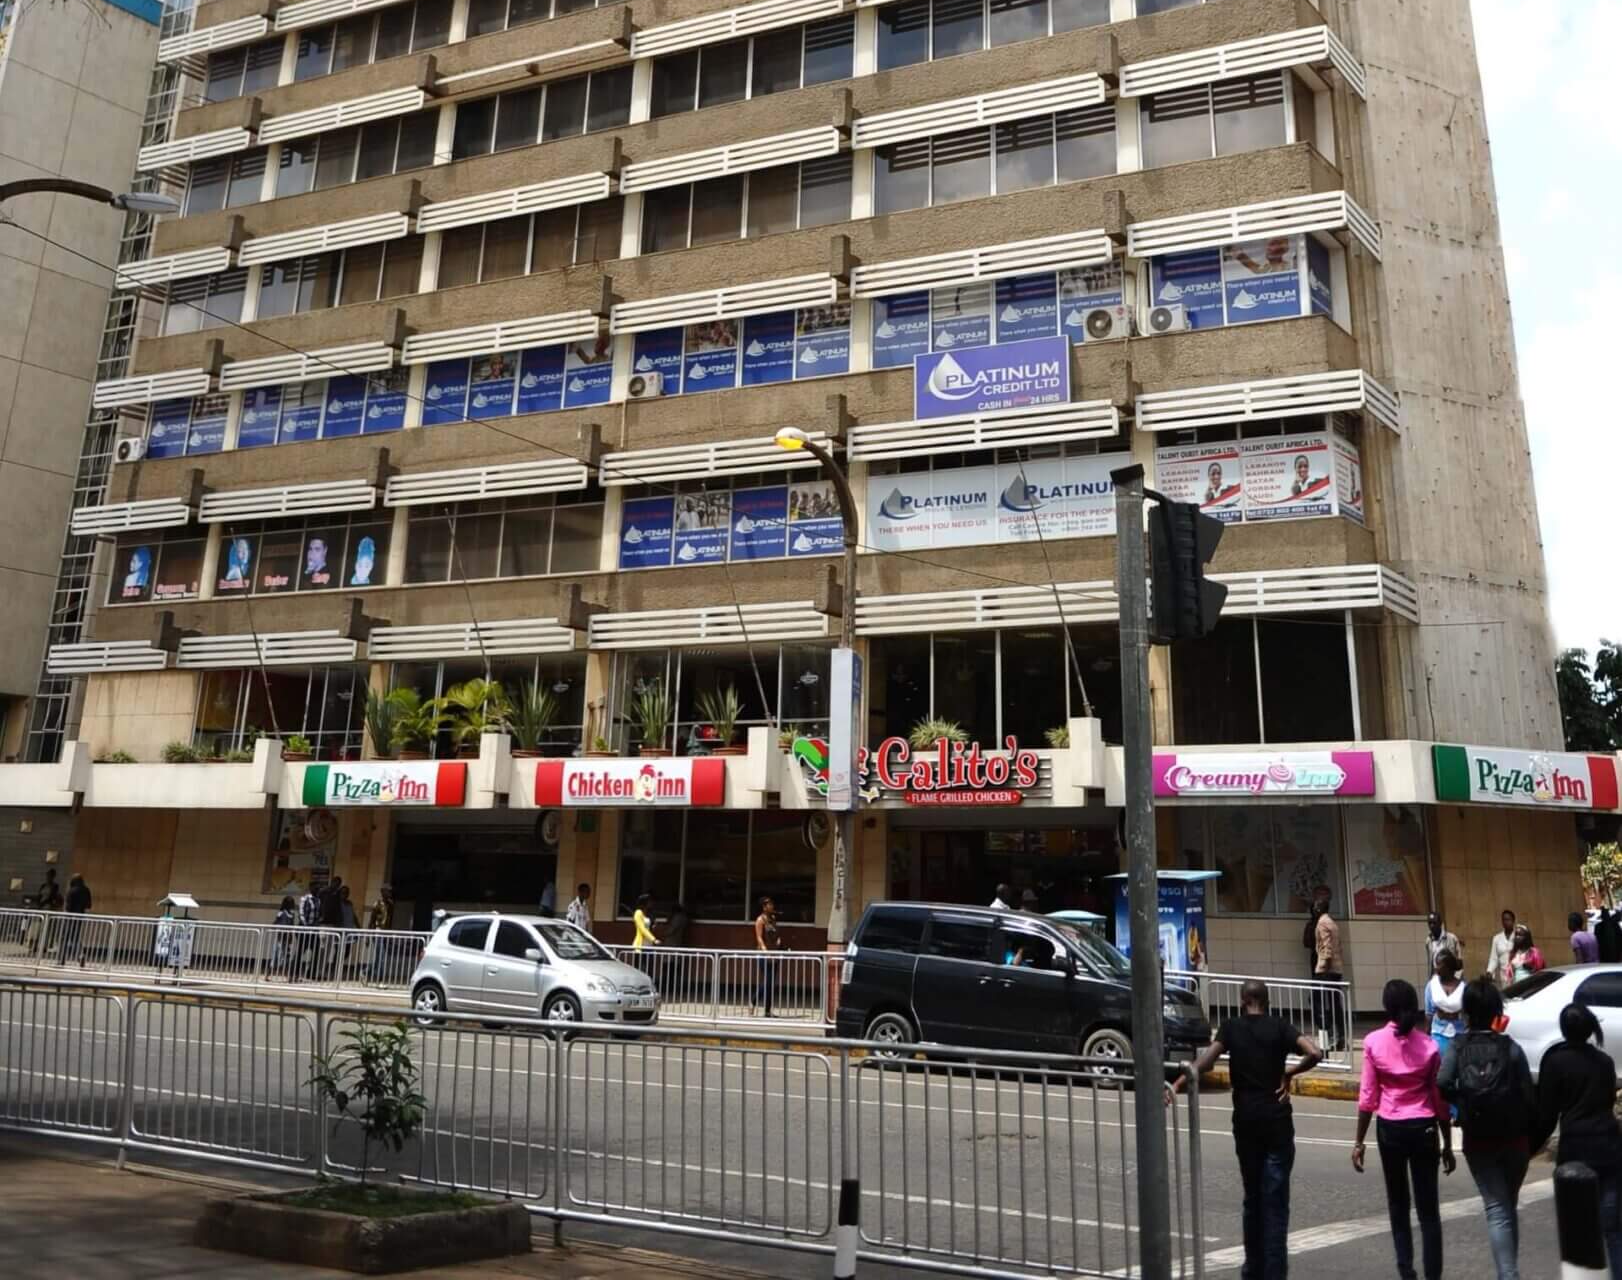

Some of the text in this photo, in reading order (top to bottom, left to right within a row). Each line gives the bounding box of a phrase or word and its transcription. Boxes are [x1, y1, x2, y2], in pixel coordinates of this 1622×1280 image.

[945, 360, 1060, 389] PLATINUM
[982, 376, 1060, 396] CREDIT LTD
[977, 399, 1002, 411] CASH
[1003, 398, 1012, 408] IN
[900, 492, 987, 510] PLATINUM
[1024, 481, 1116, 501] PLATINU
[1050, 511, 1069, 519] FOR
[1070, 509, 1089, 517] THE
[1090, 507, 1116, 515] PEOP
[879, 525, 905, 535] THERE
[906, 524, 930, 532] WHEN
[932, 522, 950, 530] YOU
[951, 520, 975, 528] NEED
[876, 735, 1038, 790] Galito's
[332, 772, 381, 799] Pizza
[567, 771, 686, 797] Chicken inn
[1169, 765, 1340, 793] Creamy Inn
[1475, 757, 1535, 795] Pizza
[911, 792, 1012, 803] FLAME GRILLED CHICKEN
